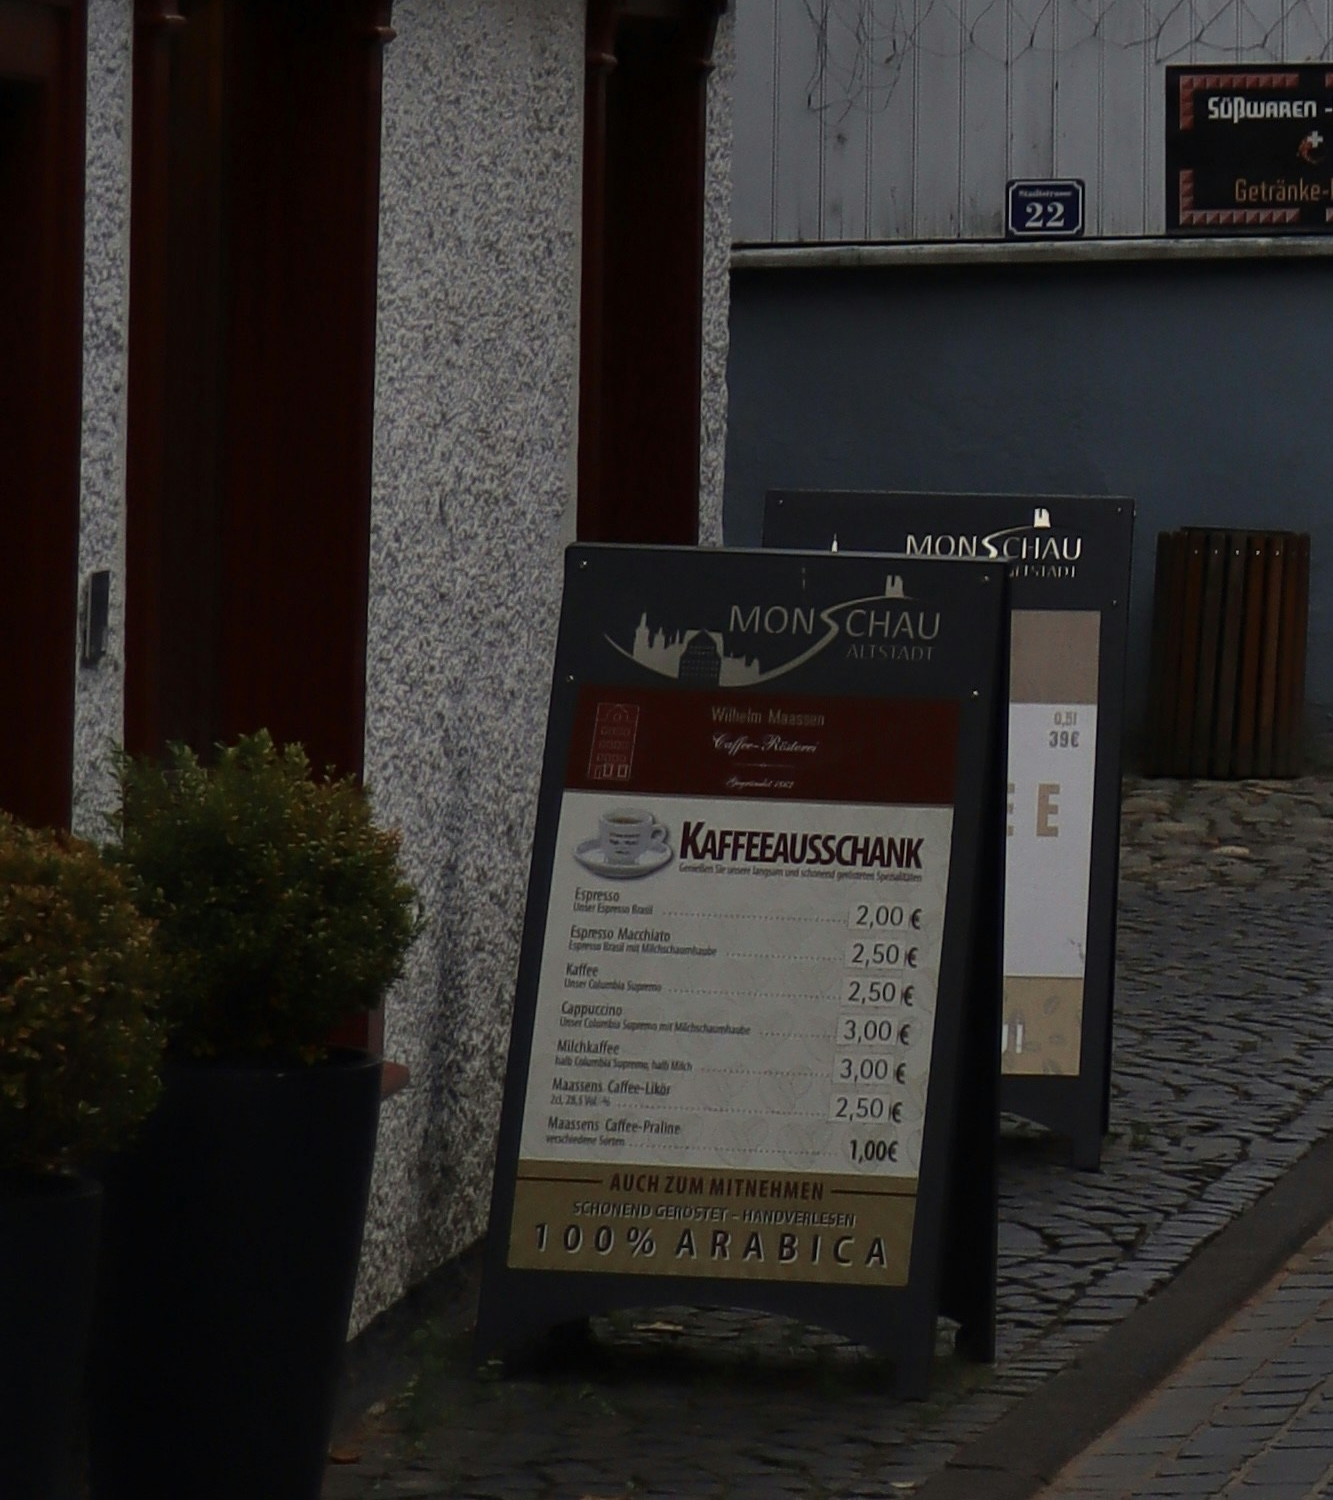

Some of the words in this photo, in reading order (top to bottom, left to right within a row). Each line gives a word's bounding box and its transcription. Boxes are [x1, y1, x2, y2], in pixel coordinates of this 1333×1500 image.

[1025, 201, 1065, 228] 22
[906, 531, 1082, 560] MONSCHAU
[728, 603, 942, 642] MONSCHAU
[846, 643, 936, 662] ALTSTADT
[711, 705, 762, 725] Wilhelm
[768, 708, 825, 728] Maassen
[679, 820, 924, 870] KAFFEEAUSSCHANK
[575, 887, 620, 905] Espresso
[857, 904, 904, 929] 2,00
[911, 908, 922, 931] €
[570, 925, 614, 943] Espresso
[617, 927, 671, 942] Macchiato
[852, 943, 899, 967] 2,50
[907, 947, 919, 968] €
[566, 963, 598, 977] Kaffee
[848, 981, 896, 1005] 2,50
[902, 985, 914, 1007] €
[561, 1001, 622, 1017] Cappuccino
[844, 1019, 892, 1044] 3,00
[898, 1023, 910, 1046] €
[557, 1039, 620, 1054] Milchkaffee
[840, 1059, 888, 1083] 3,00
[895, 1063, 906, 1085] €
[552, 1077, 603, 1093] Maassens
[607, 1079, 671, 1097] Caffee-Likör
[836, 1098, 884, 1123] 2,50
[891, 1102, 902, 1124] €
[547, 1116, 600, 1132] Maassens
[605, 1118, 681, 1135] Caffee-Praline
[599, 1135, 626, 1147] Sorten
[610, 1173, 660, 1194] AUCH
[664, 1175, 705, 1196] ZUM
[710, 1178, 825, 1202] MITNEHMEN
[573, 1201, 652, 1219] SCHONEND
[742, 1209, 856, 1228] HANDVERLESEN
[534, 1222, 656, 1259] 100%
[675, 1228, 889, 1269] ARABICA
